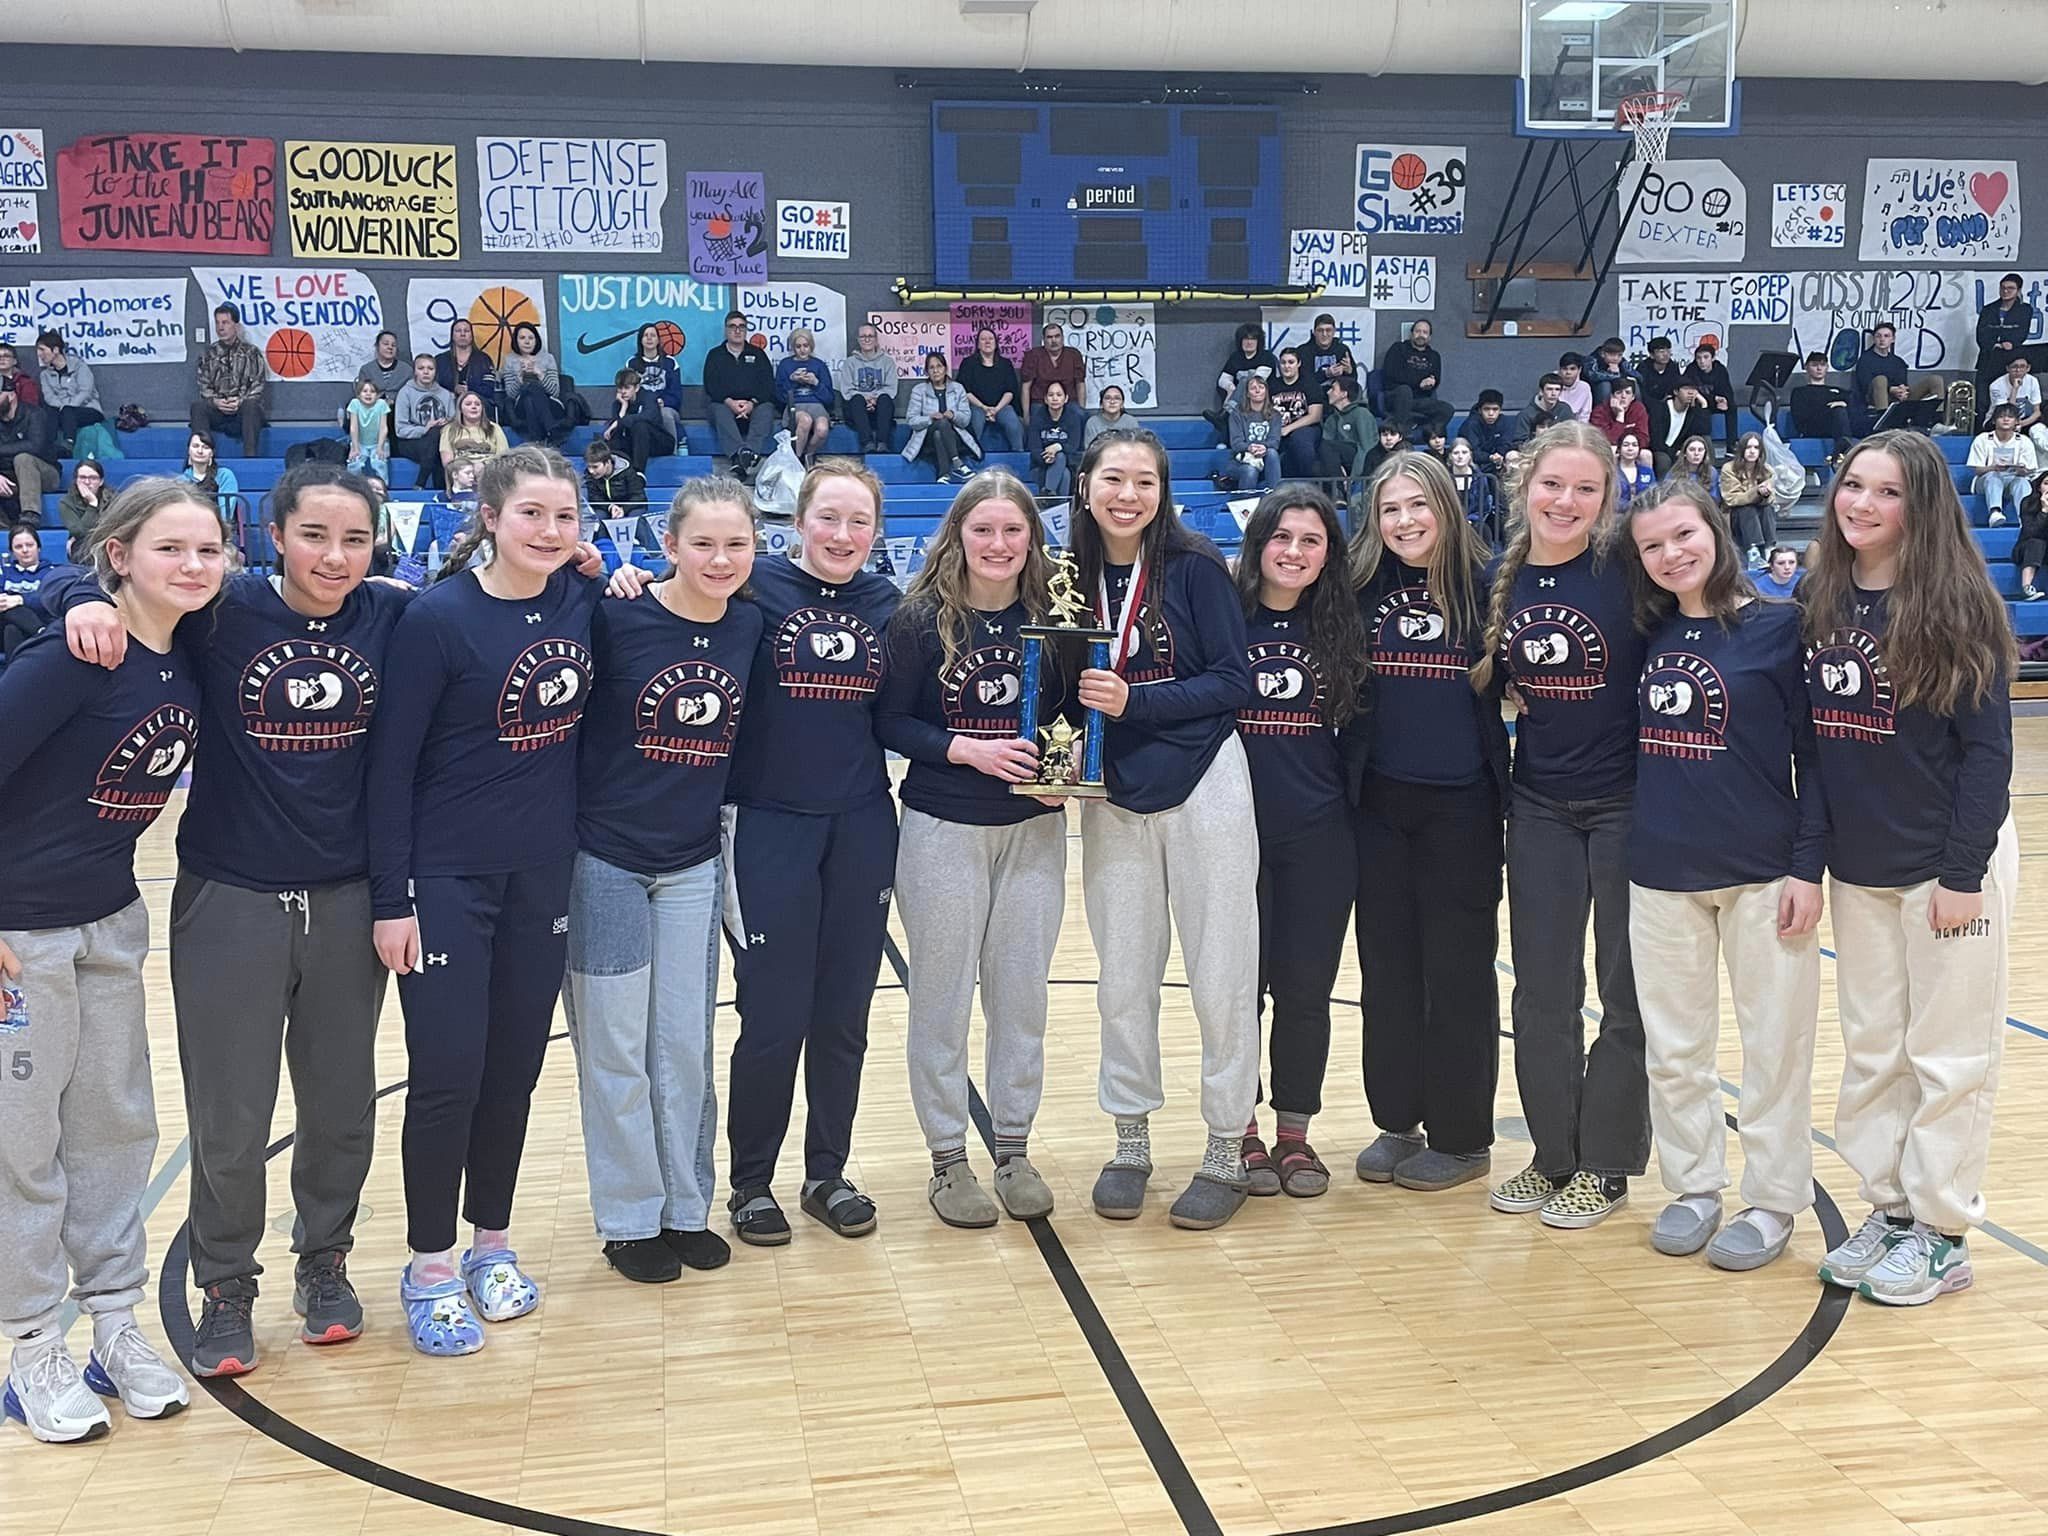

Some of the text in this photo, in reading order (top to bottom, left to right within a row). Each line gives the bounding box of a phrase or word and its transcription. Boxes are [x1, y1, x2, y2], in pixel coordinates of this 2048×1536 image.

[0, 135, 14, 157] O
[91, 136, 248, 173] TAKE IT
[0, 160, 45, 187] GERS
[487, 139, 658, 187] DEFENSE
[179, 166, 273, 204] HP
[1086, 184, 1135, 207] period
[1409, 158, 1466, 214] #30
[1777, 184, 1821, 201] LETS
[1912, 169, 1955, 202] We
[79, 199, 272, 241] JUNEAU BEARS
[486, 186, 649, 233] GET TOUGH
[782, 205, 847, 229] GO #1
[1356, 193, 1462, 235] Shaunessi
[292, 214, 458, 257] WOLVERINES
[780, 229, 847, 252] JHERYEL
[1639, 220, 1718, 250] DEXTER
[1807, 225, 1844, 243] #25
[1936, 212, 1989, 248] BAND
[1293, 232, 1368, 256] YAY PEP
[694, 256, 764, 276] Come True
[1312, 260, 1367, 288] BAND
[1375, 257, 1429, 276] ASHA
[217, 273, 348, 299] WE LOVE
[562, 274, 631, 312] JUST
[1373, 275, 1431, 303] #40
[1622, 279, 1727, 304] TAKE IT
[1758, 274, 1790, 297] PEP
[1889, 271, 1964, 311] 2023
[36, 288, 172, 319] Sophomores
[284, 295, 380, 326] SENIORS
[955, 305, 1024, 319] SORRY YOU
[1646, 306, 1706, 321] TO THE
[1731, 297, 1788, 322] BAND
[38, 323, 69, 338] Krl
[126, 319, 183, 338] John
[871, 314, 946, 335] Roses are
[1047, 307, 1088, 329] GO
[1887, 309, 1927, 329] THIS
[119, 342, 157, 356] Noah
[955, 334, 977, 345] GUA
[1068, 329, 1155, 351] ORDOVA
[912, 366, 929, 377] YO
[616, 526, 630, 542] H
[1053, 513, 1067, 531] E
[771, 534, 785, 548] O
[894, 545, 906, 560] E
[826, 613, 880, 663] CHRISTI
[1545, 608, 1602, 662] CHRISTI
[1372, 651, 1393, 662] ADY
[245, 645, 374, 704] LUMEN CHRISTI
[1376, 666, 1456, 680] BASKETBALL
[641, 665, 741, 726] LUMEN CHRISTI
[790, 687, 864, 701] BASKETBALL
[1677, 655, 1723, 720] CHRISTI
[247, 720, 282, 734] LADY
[1243, 725, 1311, 736] ASKETBALL
[260, 737, 353, 752] BASKETBALL
[0, 1050, 33, 1081] 5
